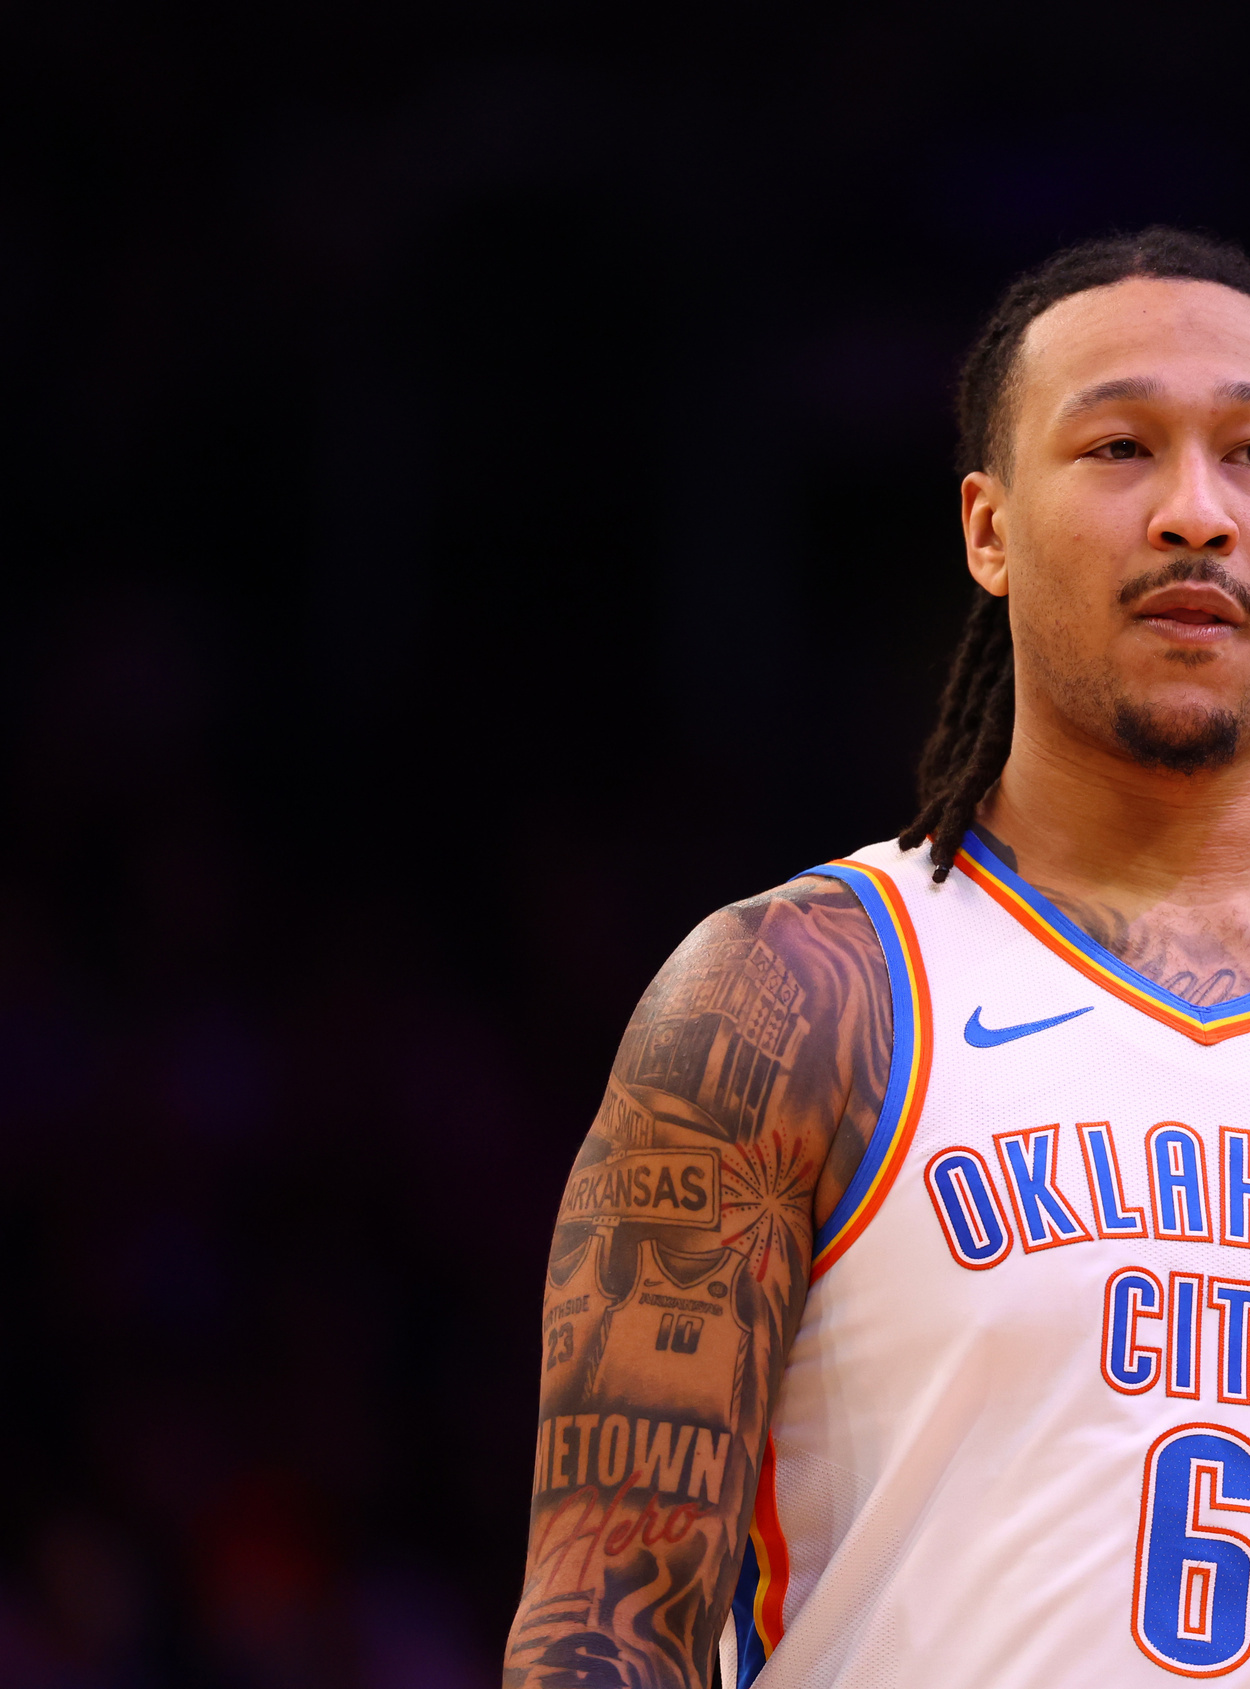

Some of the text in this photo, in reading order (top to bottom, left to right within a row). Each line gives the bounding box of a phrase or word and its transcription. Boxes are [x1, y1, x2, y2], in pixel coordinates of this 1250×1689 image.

[615, 1098, 650, 1147] SMITH
[565, 1165, 707, 1212] ARKANSAS
[546, 1322, 574, 1372] 23
[655, 1312, 705, 1355] 10
[535, 1470, 714, 1596] Hero
